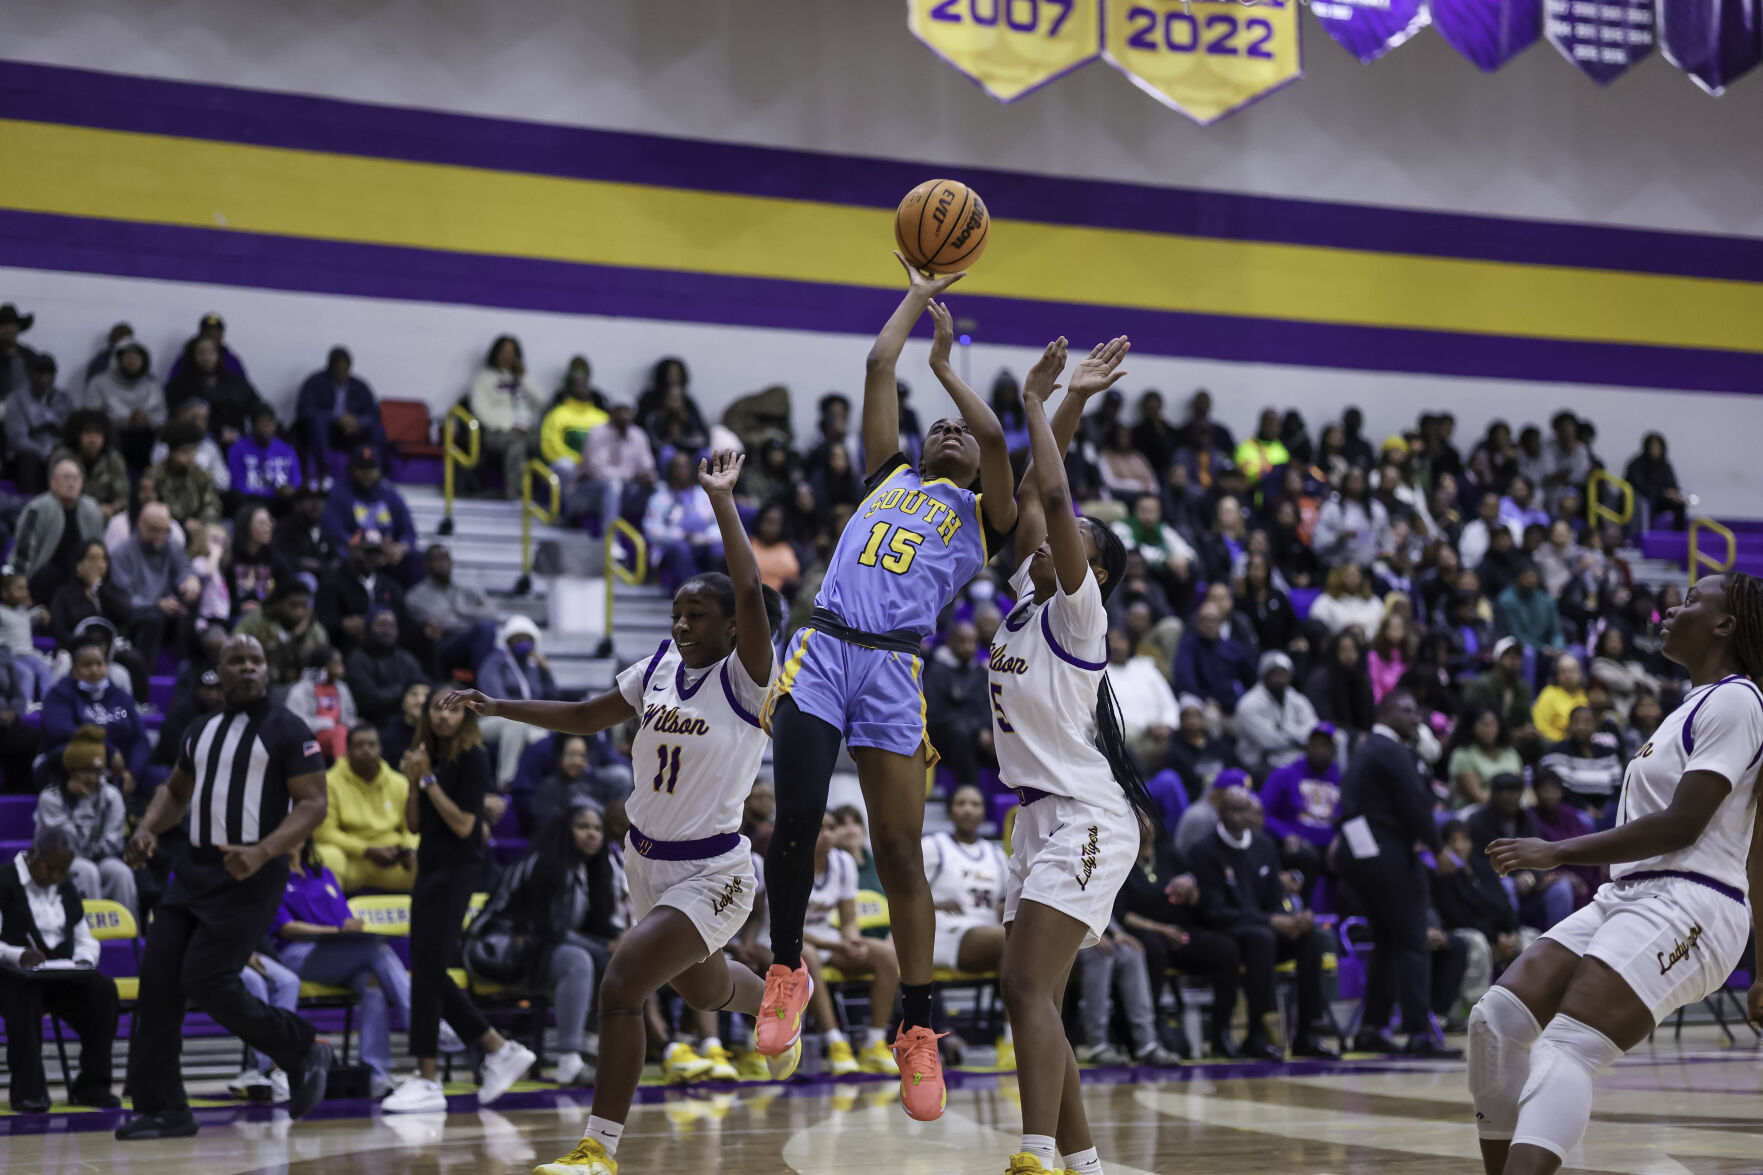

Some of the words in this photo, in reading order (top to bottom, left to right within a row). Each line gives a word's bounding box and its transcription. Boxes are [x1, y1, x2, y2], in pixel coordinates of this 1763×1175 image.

[930, 0, 1074, 37] 2007
[1128, 7, 1273, 59] 2022
[951, 198, 985, 249] Wilson
[864, 488, 963, 548] SOUTH
[857, 520, 926, 576] 15
[642, 703, 710, 736] Wilson
[653, 744, 682, 795] 11
[356, 907, 410, 925] TIGER
[1657, 937, 1690, 976] Lady
